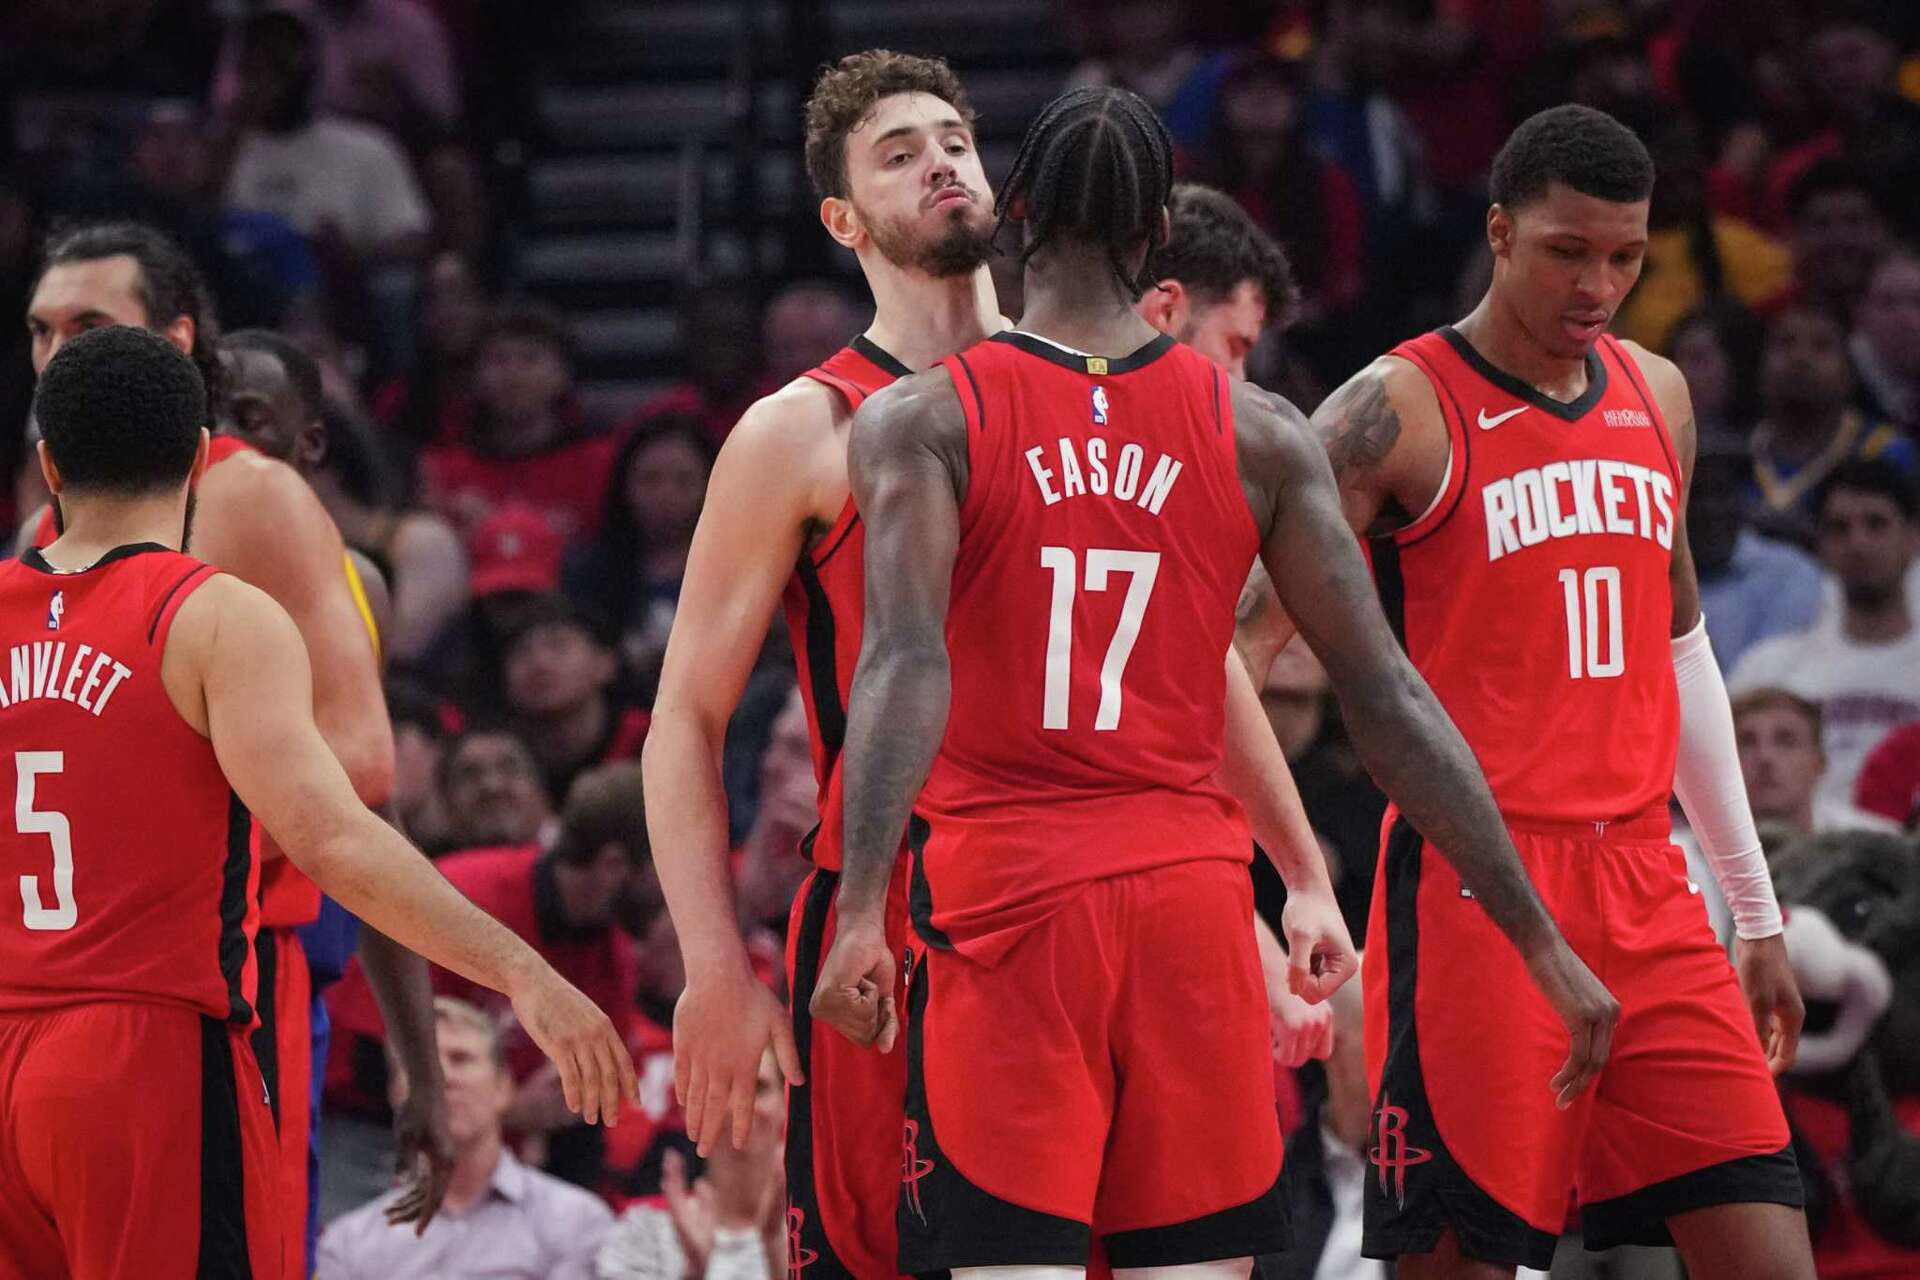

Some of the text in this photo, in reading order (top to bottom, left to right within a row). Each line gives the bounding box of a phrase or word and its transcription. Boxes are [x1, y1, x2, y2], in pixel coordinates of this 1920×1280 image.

[1025, 438, 1183, 516] EASON
[1482, 459, 1673, 562] ROCKETS
[1041, 547, 1160, 730] 17
[1558, 566, 1625, 678] 10
[15, 751, 77, 930] 5
